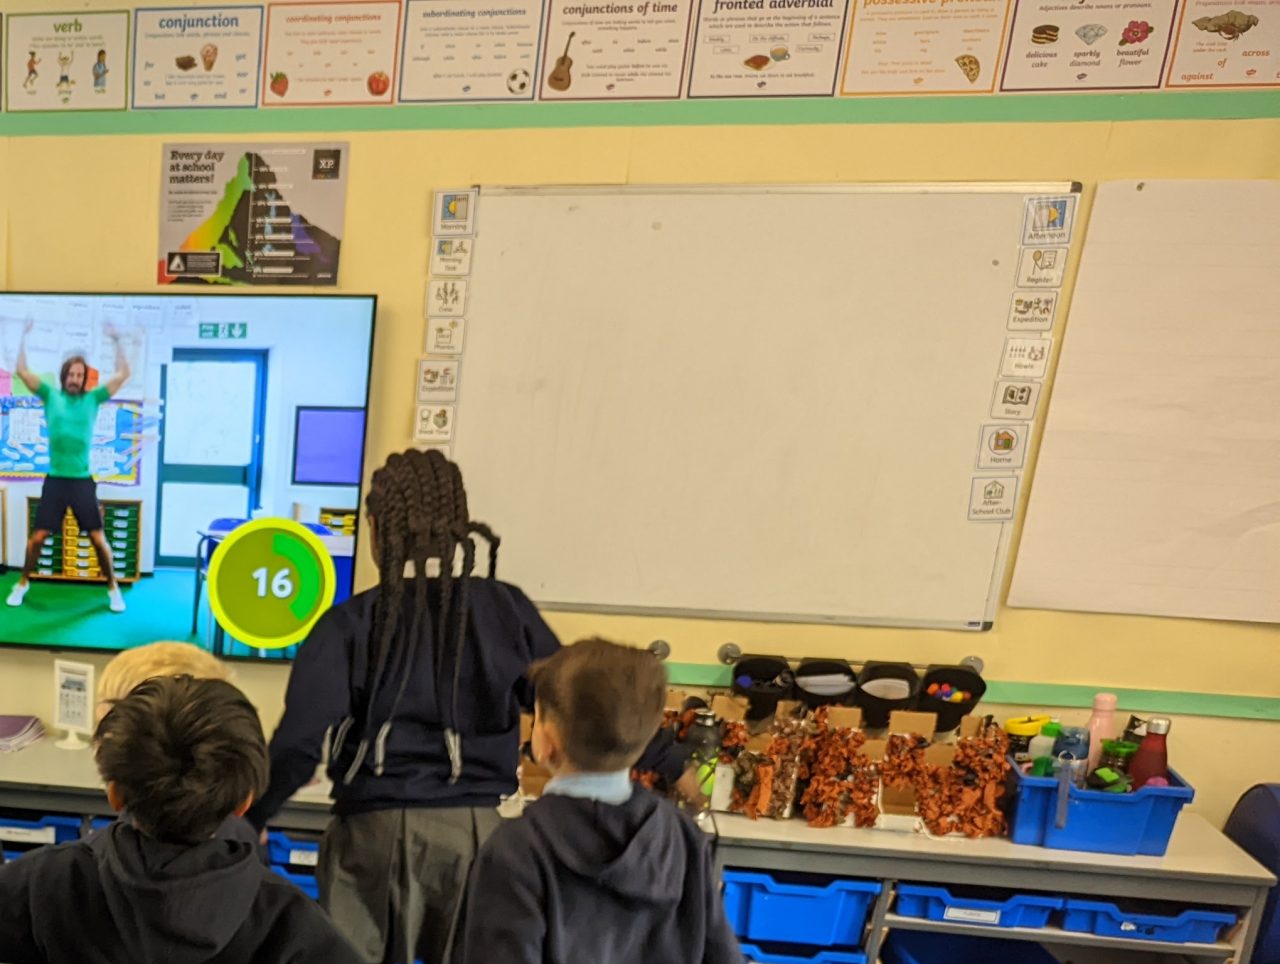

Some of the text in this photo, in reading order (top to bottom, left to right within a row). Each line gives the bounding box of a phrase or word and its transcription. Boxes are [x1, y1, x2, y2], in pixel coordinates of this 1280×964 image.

[563, 1, 678, 17] conjunctions of time
[712, 0, 834, 14] fronted adverbial
[423, 8, 526, 18] subordinating conjunctions
[159, 13, 239, 32] conjunction
[286, 14, 381, 24] coordinating conjunctions
[53, 18, 83, 33] verb
[1026, 51, 1058, 59] delicious
[1073, 49, 1101, 59] sparkly
[1116, 48, 1149, 58] beautiful
[1069, 59, 1101, 67] diamond
[1118, 58, 1143, 68] flower
[1217, 58, 1228, 68] of
[1181, 72, 1214, 82] against
[170, 150, 225, 163] Every day
[169, 162, 215, 173] at school
[169, 174, 214, 184] matters!
[440, 223, 467, 232] Morning
[1027, 230, 1066, 240] Afternoon
[1026, 275, 1054, 285] Register
[1012, 315, 1048, 324] Expedition
[422, 385, 454, 393] Expedition
[990, 456, 1012, 464] Home
[972, 507, 1012, 515] School Club
[251, 566, 293, 600] 16
